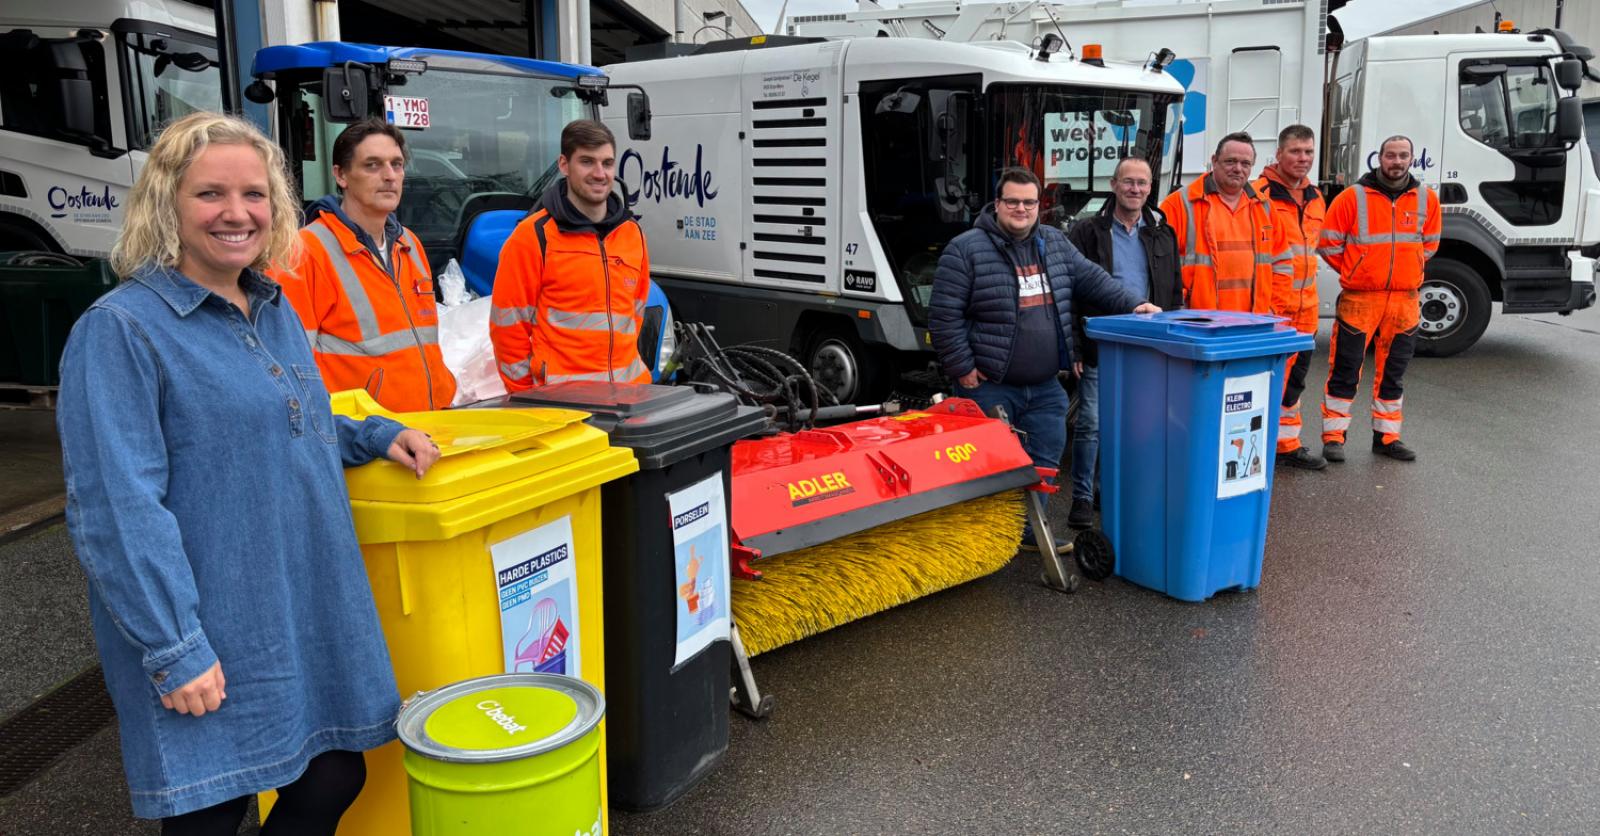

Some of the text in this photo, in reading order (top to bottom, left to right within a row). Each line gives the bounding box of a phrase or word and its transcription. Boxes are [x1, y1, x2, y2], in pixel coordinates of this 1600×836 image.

[404, 112, 429, 126] 728
[619, 143, 719, 208] Oostende
[1447, 171, 1458, 179] 18
[47, 185, 120, 211] Oostende
[684, 216, 716, 228] DE STAD
[684, 229, 716, 240] AAN ZEE
[845, 243, 858, 255] 47
[855, 276, 874, 286] RAVO
[1226, 394, 1244, 402] KLEIN
[1226, 402, 1252, 412] ELECTRO
[788, 471, 851, 500] ADLER
[675, 504, 709, 528] PORSELEIN
[500, 546, 567, 585] HARDE PLASTICS
[501, 584, 517, 597] GEEN
